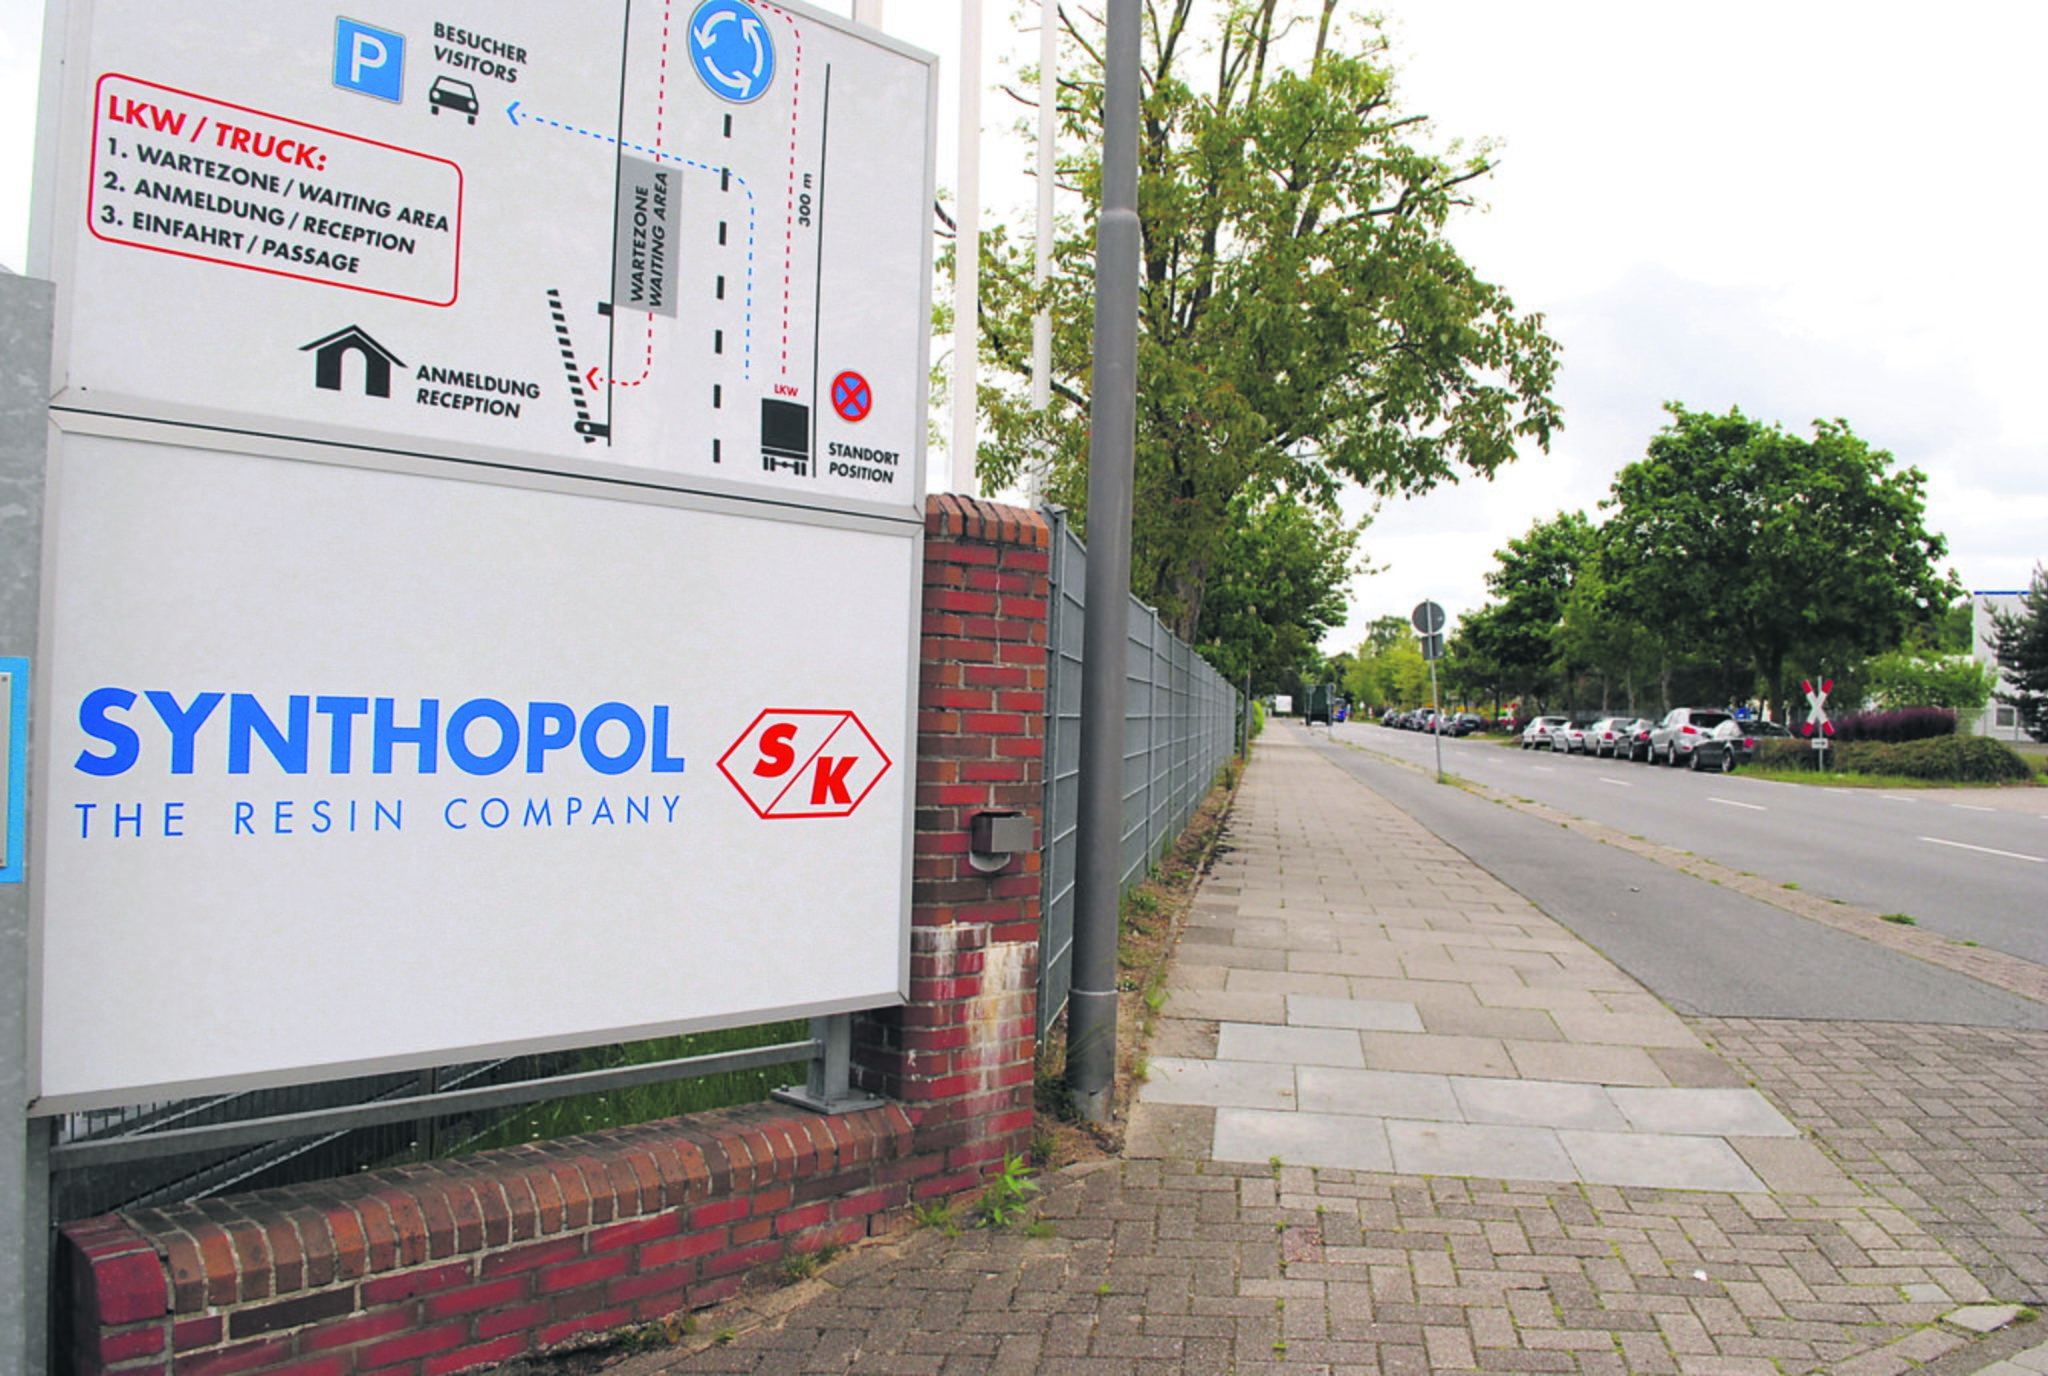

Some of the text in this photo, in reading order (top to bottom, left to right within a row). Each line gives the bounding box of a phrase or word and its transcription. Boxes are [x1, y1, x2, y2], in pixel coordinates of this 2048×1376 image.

[351, 32, 388, 83] P
[433, 21, 528, 65] BESUCHER
[433, 44, 518, 84] VISITORS
[108, 94, 188, 137] LKW
[215, 122, 328, 172] TRUCK:
[108, 137, 128, 159] 1.
[136, 143, 280, 194] WARTEZONE
[298, 182, 391, 219] WAITING
[396, 207, 449, 233] AREA
[798, 172, 813, 228] 300 m
[103, 170, 126, 193] 2.
[133, 178, 285, 226] ANMELDUNG
[302, 215, 417, 255] RECEPTION
[100, 204, 124, 226] 3.
[132, 211, 245, 250] EINFAHRT
[261, 238, 361, 274] PASSAGE
[630, 185, 650, 303] WARTEZONE
[649, 171, 668, 308] WAITING AREA
[416, 364, 542, 400] ANMELDUNG
[416, 387, 521, 419] RECEPTION
[773, 383, 799, 397] LKW
[828, 442, 900, 466] STANDORT
[829, 461, 895, 484] POSITION
[73, 687, 686, 777] SYNTHOPOL
[73, 795, 681, 839] THE RESIN COMPANY
